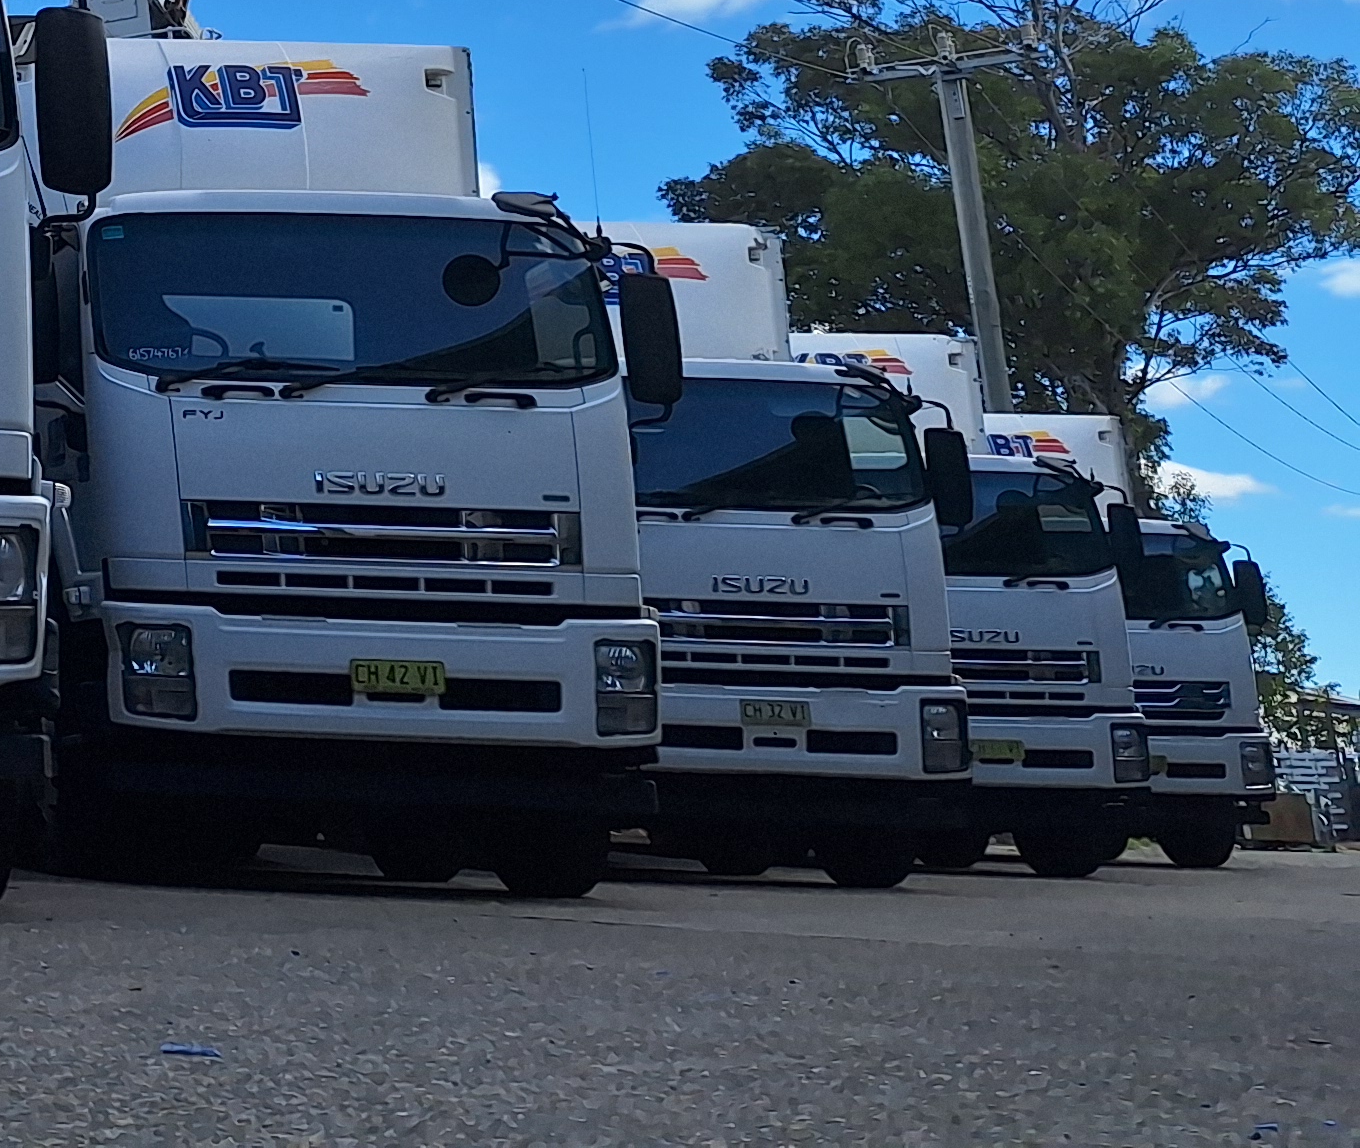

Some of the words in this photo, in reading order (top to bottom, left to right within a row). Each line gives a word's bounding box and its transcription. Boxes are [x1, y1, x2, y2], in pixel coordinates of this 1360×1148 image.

[167, 64, 303, 129] KBT
[182, 409, 224, 420] FYJ
[986, 433, 1034, 459] BT
[314, 470, 446, 497] ISUZU
[711, 574, 810, 596] ISUZU
[949, 626, 1020, 644] SUZU
[355, 663, 379, 684] CH
[386, 664, 410, 685] 42
